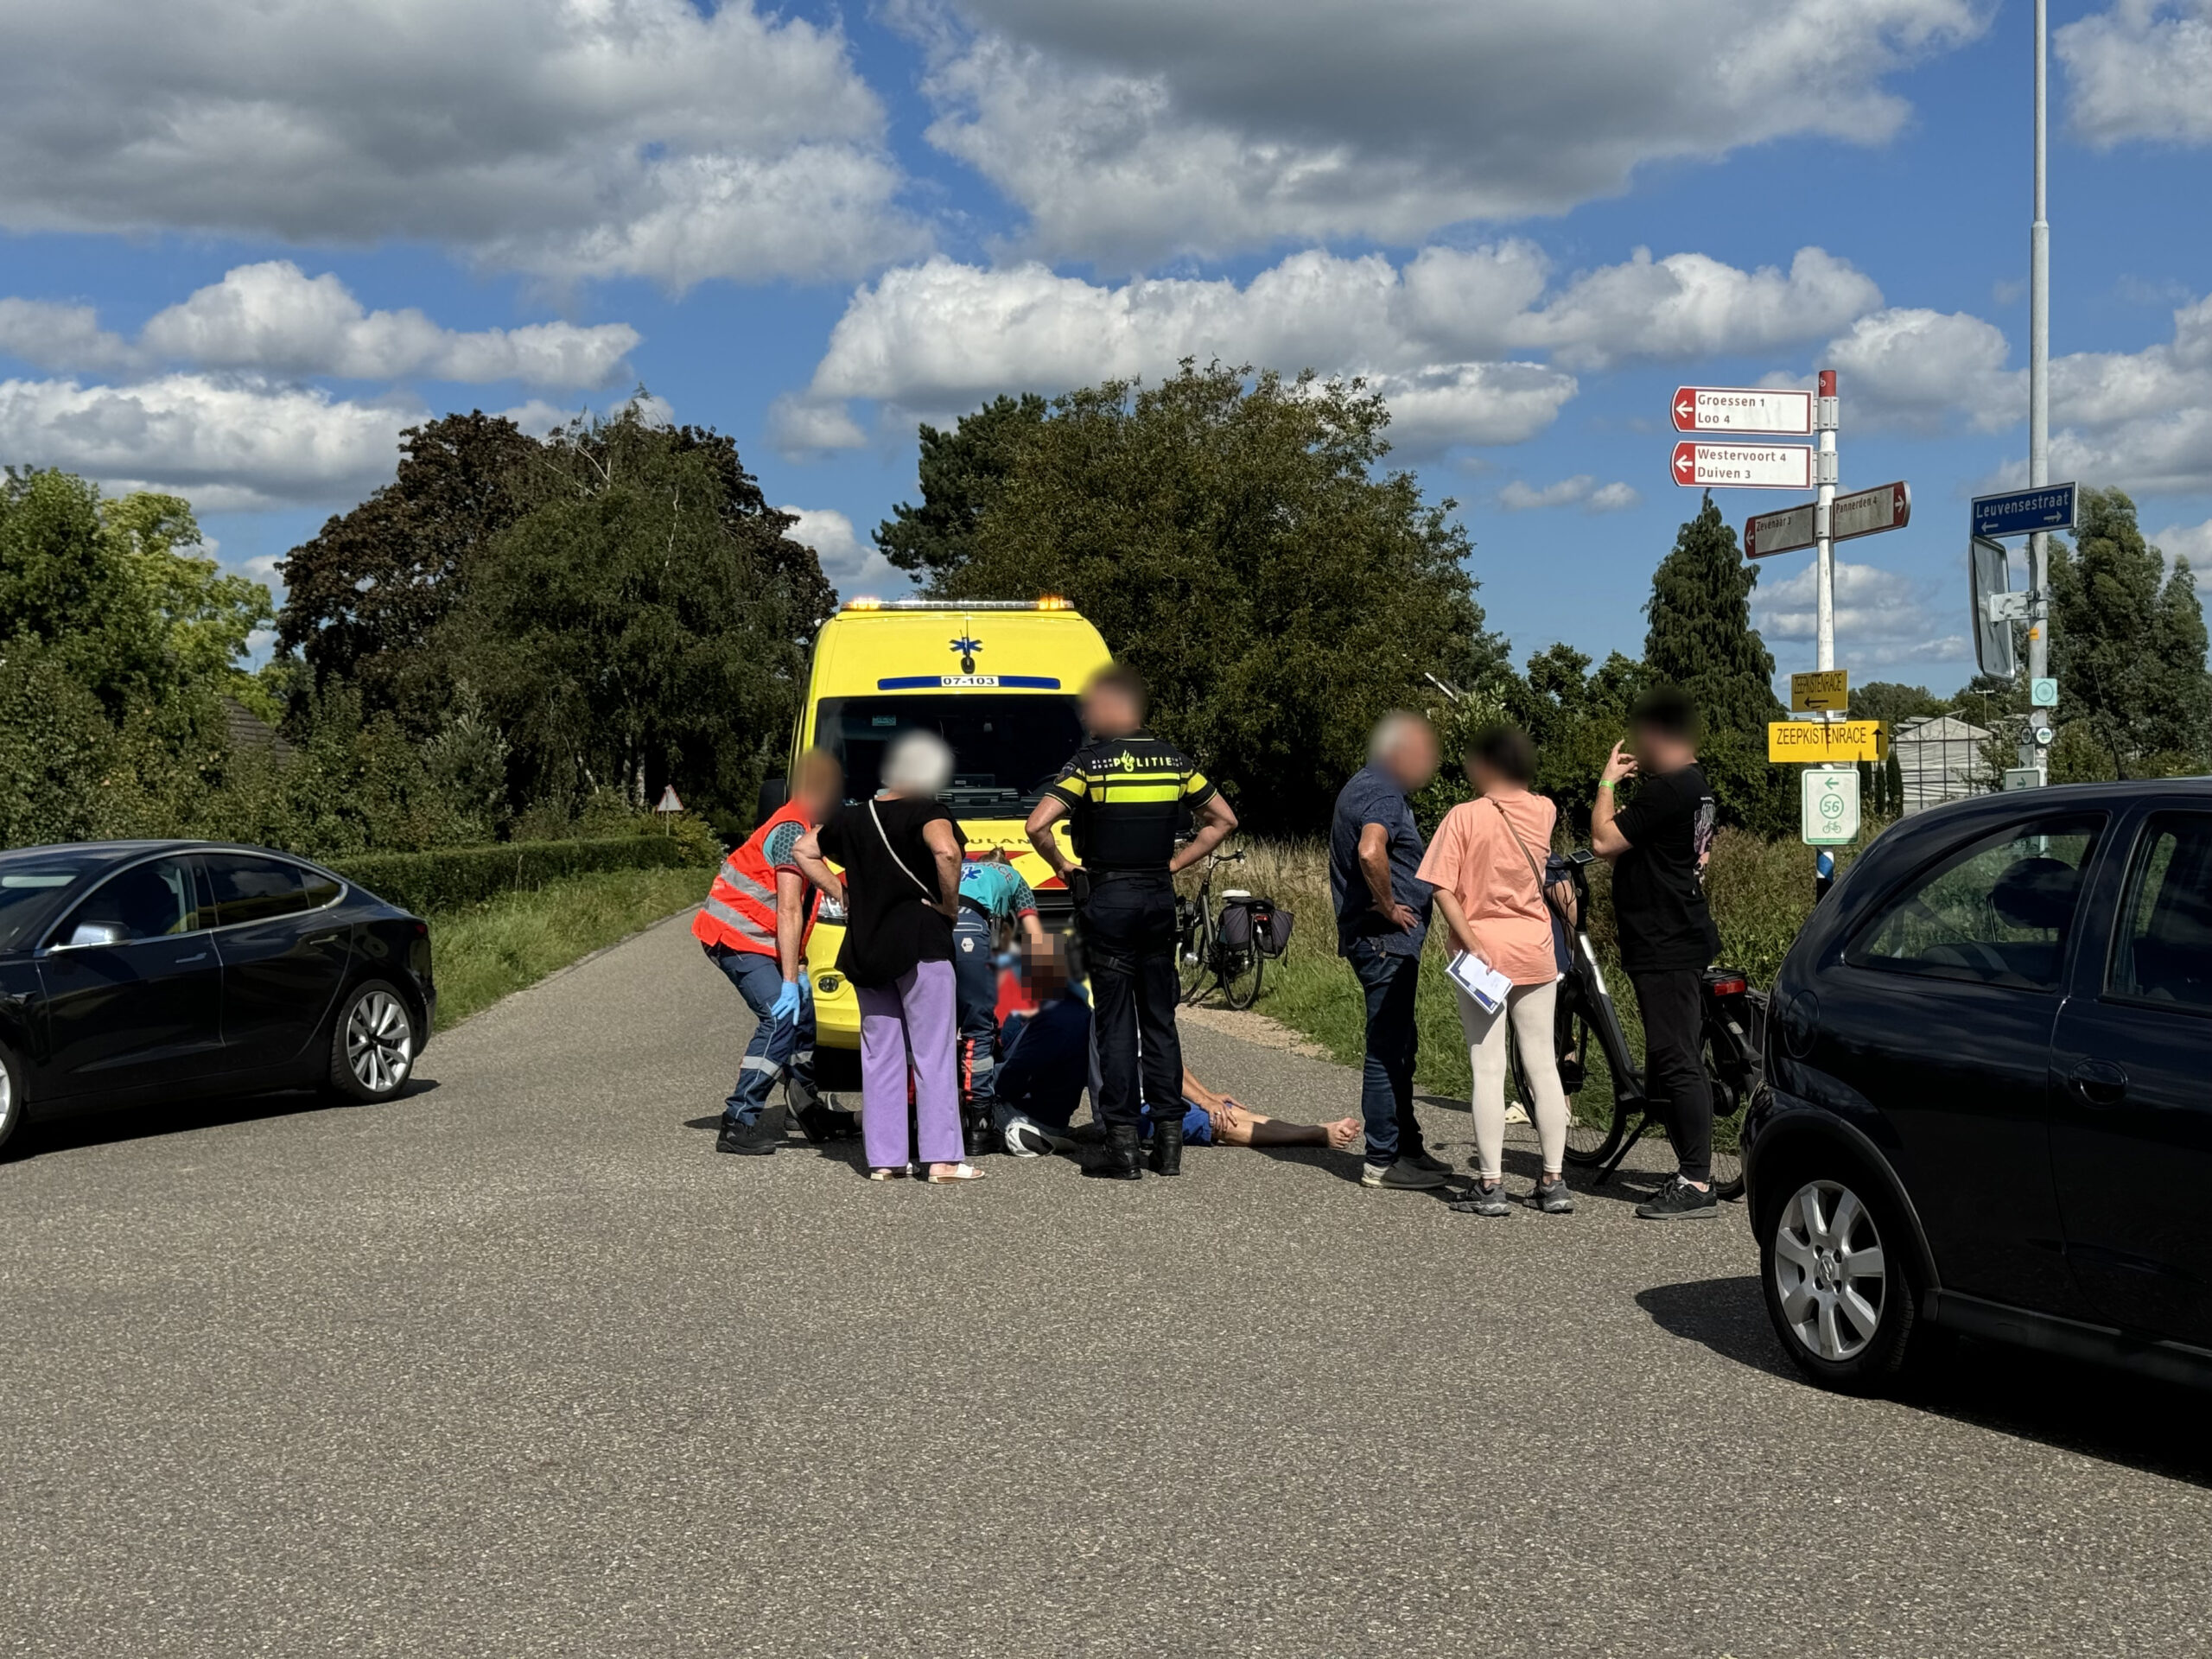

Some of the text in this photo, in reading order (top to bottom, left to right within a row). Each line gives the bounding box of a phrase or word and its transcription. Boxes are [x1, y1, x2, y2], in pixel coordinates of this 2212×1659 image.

[1698, 394, 1764, 407] Groessen 1
[1698, 412, 1730, 423] Loo 4
[1698, 448, 1776, 461] Westervoort
[1698, 467, 1751, 479] Duiven 3
[1836, 497, 1872, 514] Pannerden
[1976, 491, 2069, 518] Leuvensestraat
[1757, 518, 1786, 532] Zevenaar
[1794, 673, 1842, 694] ZEEPKISTENRACE
[1777, 727, 1867, 745] ZEEPKISTENRACE
[1113, 753, 1173, 772] POLITIE
[1823, 800, 1840, 813] 56
